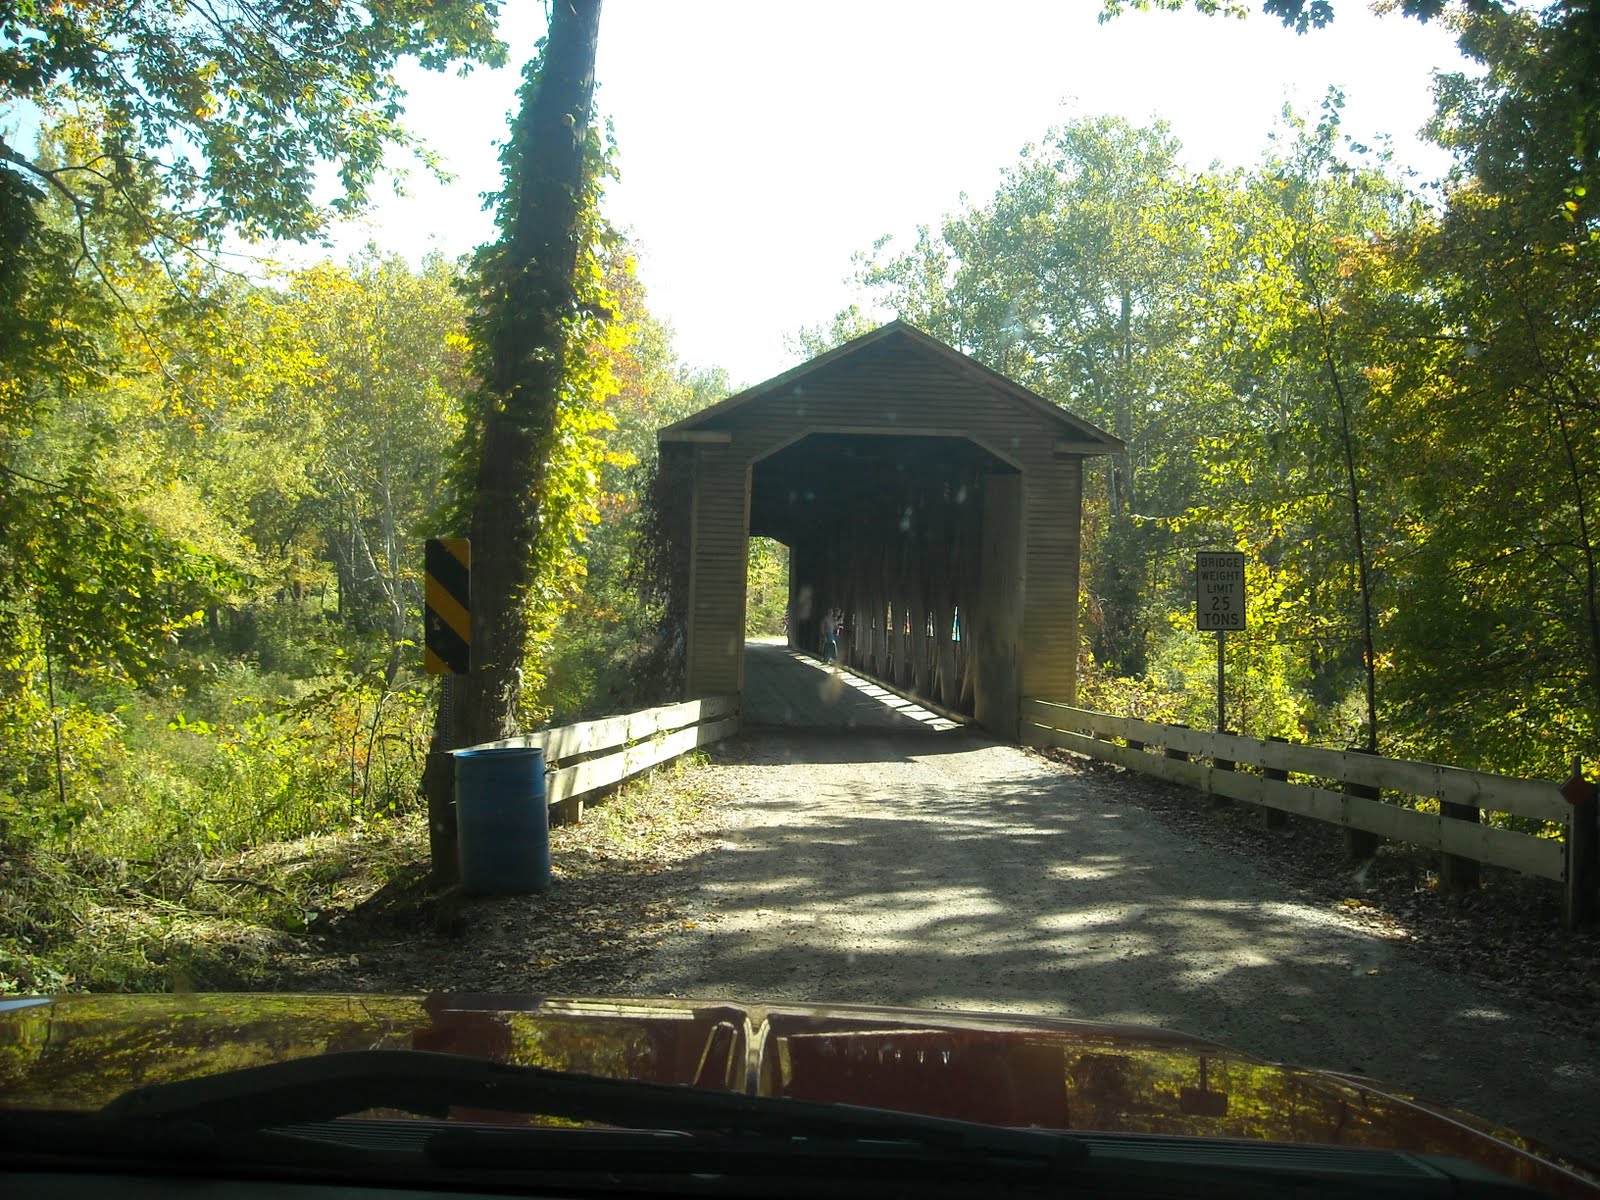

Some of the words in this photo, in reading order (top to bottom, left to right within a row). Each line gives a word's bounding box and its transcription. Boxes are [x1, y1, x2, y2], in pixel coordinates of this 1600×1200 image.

[1201, 557, 1240, 568] BRIDGE
[1201, 571, 1240, 581] WEIGHT
[1207, 583, 1234, 594] LIMIT
[1211, 596, 1230, 611] 25
[1204, 613, 1239, 625] TONS
